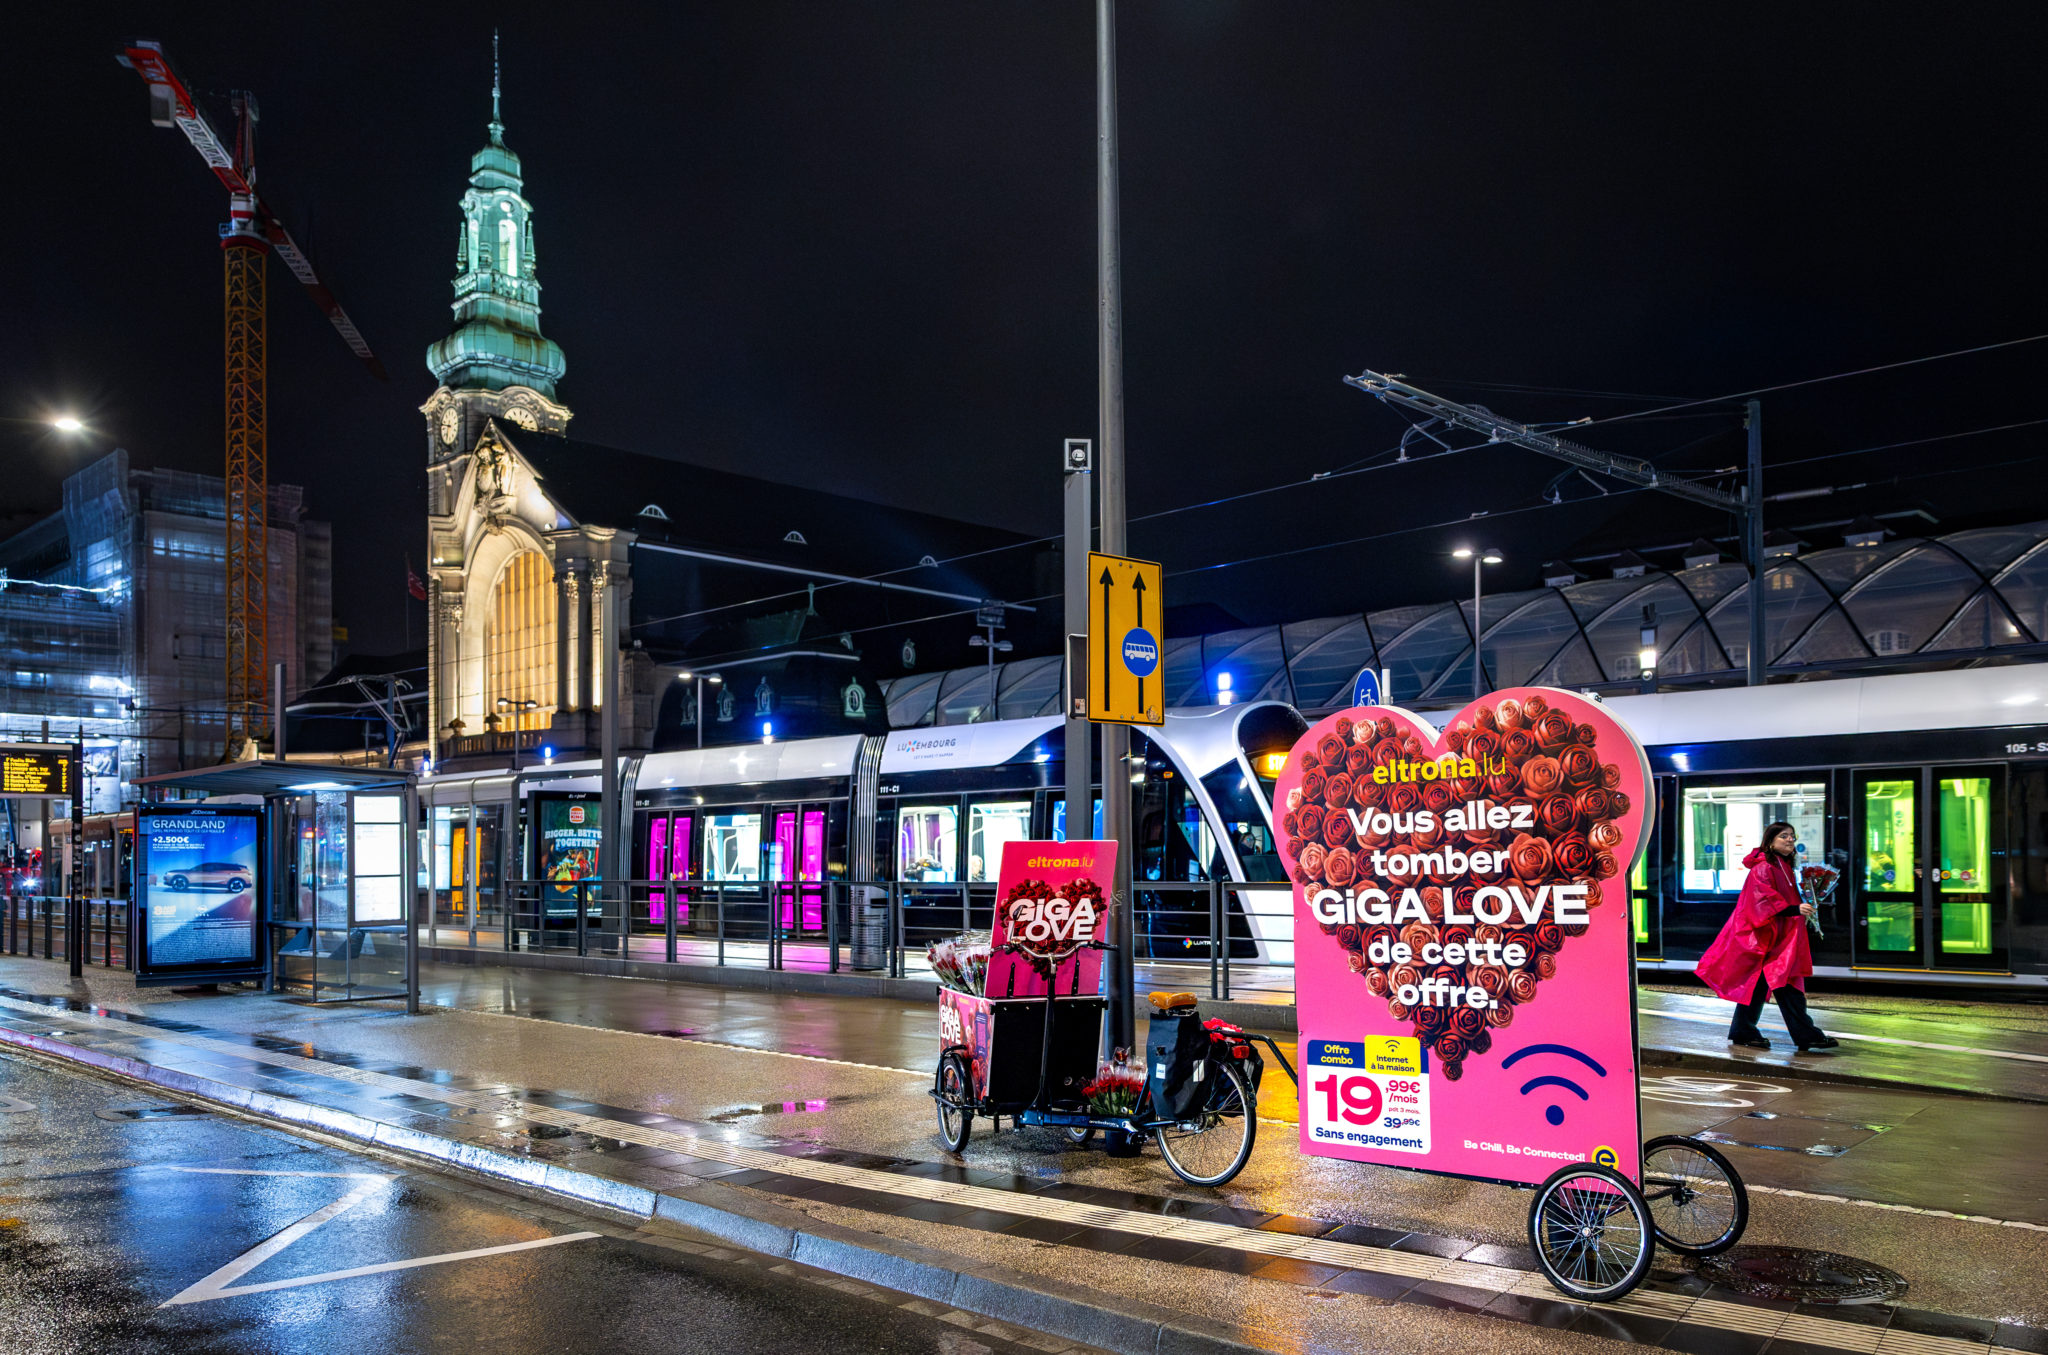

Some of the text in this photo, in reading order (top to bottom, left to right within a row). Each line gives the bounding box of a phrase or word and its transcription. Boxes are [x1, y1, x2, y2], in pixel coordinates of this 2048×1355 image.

[897, 738, 956, 752] LUXEMBOURG
[1372, 752, 1505, 784] eltrona.lu
[152, 819, 226, 829] GRANDLAND
[1347, 800, 1534, 836] Vous allez
[545, 828, 603, 839] BIGGER. BETTE
[555, 838, 600, 848] TOGETHER.
[1027, 856, 1094, 868] eltrona.lu
[1371, 845, 1510, 877] tomber
[1312, 885, 1590, 925] GiGA LOVE
[1006, 918, 1095, 942] LOVE
[1368, 935, 1527, 967] de cette
[1398, 978, 1499, 1009] offre.
[940, 1020, 961, 1045] LOVE
[1324, 1044, 1350, 1055] Offre
[1320, 1055, 1354, 1065] combo
[1376, 1055, 1409, 1064] Internet
[1377, 1063, 1385, 1071] la
[1386, 1064, 1415, 1073] maison
[1388, 1093, 1419, 1104] /mois
[1315, 1127, 1423, 1149] Sans engagement
[1463, 1139, 1586, 1162] Be Chill, Be Connected!
